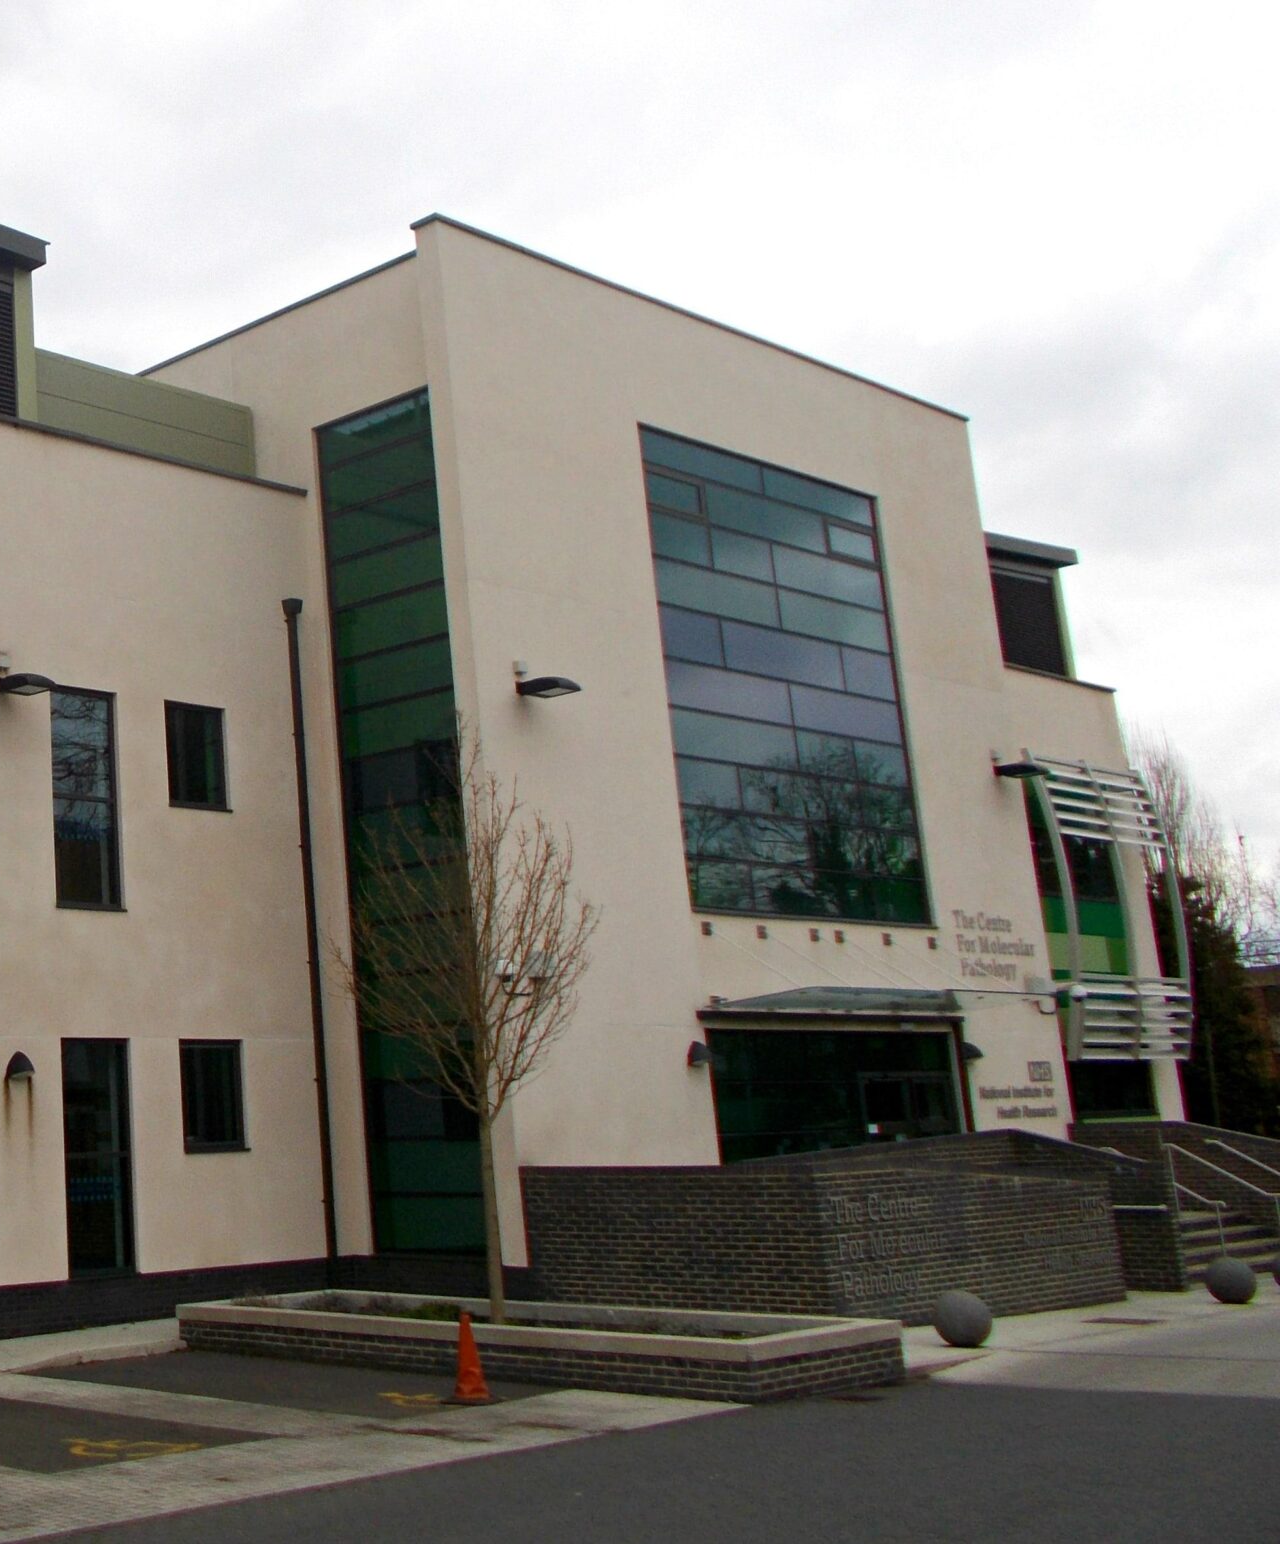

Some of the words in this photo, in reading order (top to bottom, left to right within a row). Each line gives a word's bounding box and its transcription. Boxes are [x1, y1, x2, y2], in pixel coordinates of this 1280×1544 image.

[952, 909, 975, 929] The
[977, 911, 1012, 933] Centre
[956, 934, 976, 953] For
[978, 936, 1035, 956] Molecular
[1028, 1062, 1052, 1081] NHS
[830, 1196, 863, 1223] The
[867, 1193, 919, 1221] Centre
[837, 1234, 865, 1261] For
[841, 1264, 920, 1299] Pathology
